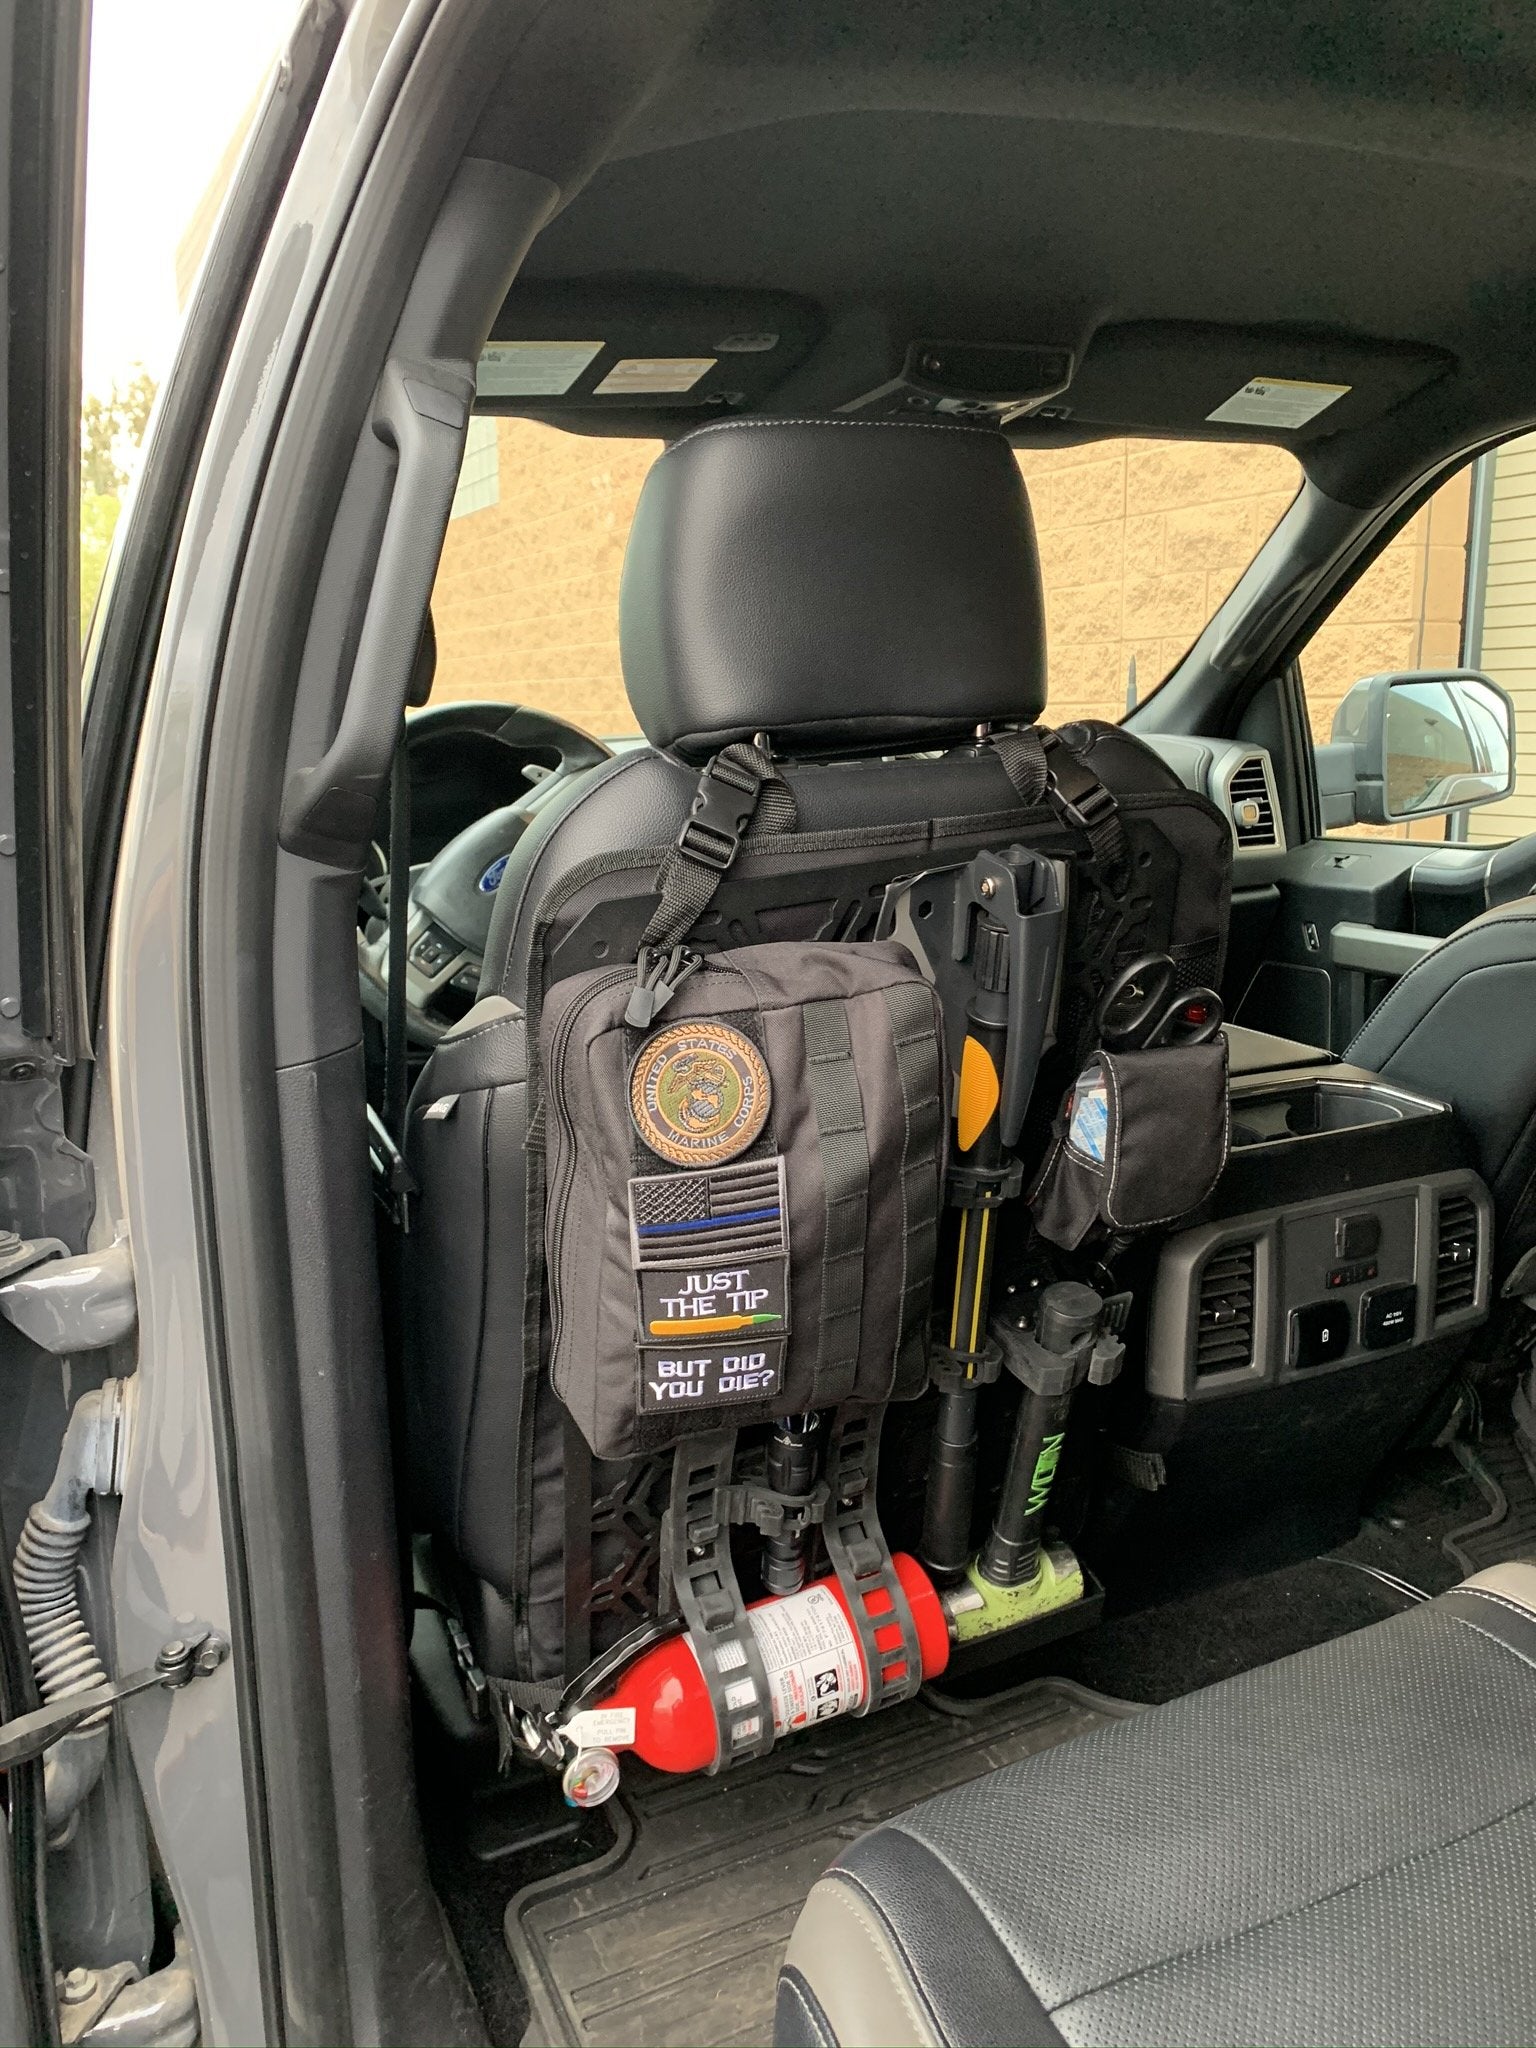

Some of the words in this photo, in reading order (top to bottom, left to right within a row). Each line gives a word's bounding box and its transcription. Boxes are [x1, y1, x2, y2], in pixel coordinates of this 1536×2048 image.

[645, 1053, 668, 1112] UNITED
[677, 1038, 738, 1060] STATES
[667, 1130, 730, 1149] MARINE
[733, 1075, 754, 1128] CORPS
[678, 1269, 751, 1296] JUST
[660, 1294, 717, 1318] THE
[726, 1288, 769, 1312] TIP
[657, 1359, 712, 1379] BUT
[722, 1352, 767, 1375] DID
[649, 1380, 704, 1401] YOU
[718, 1368, 775, 1394] DIE?
